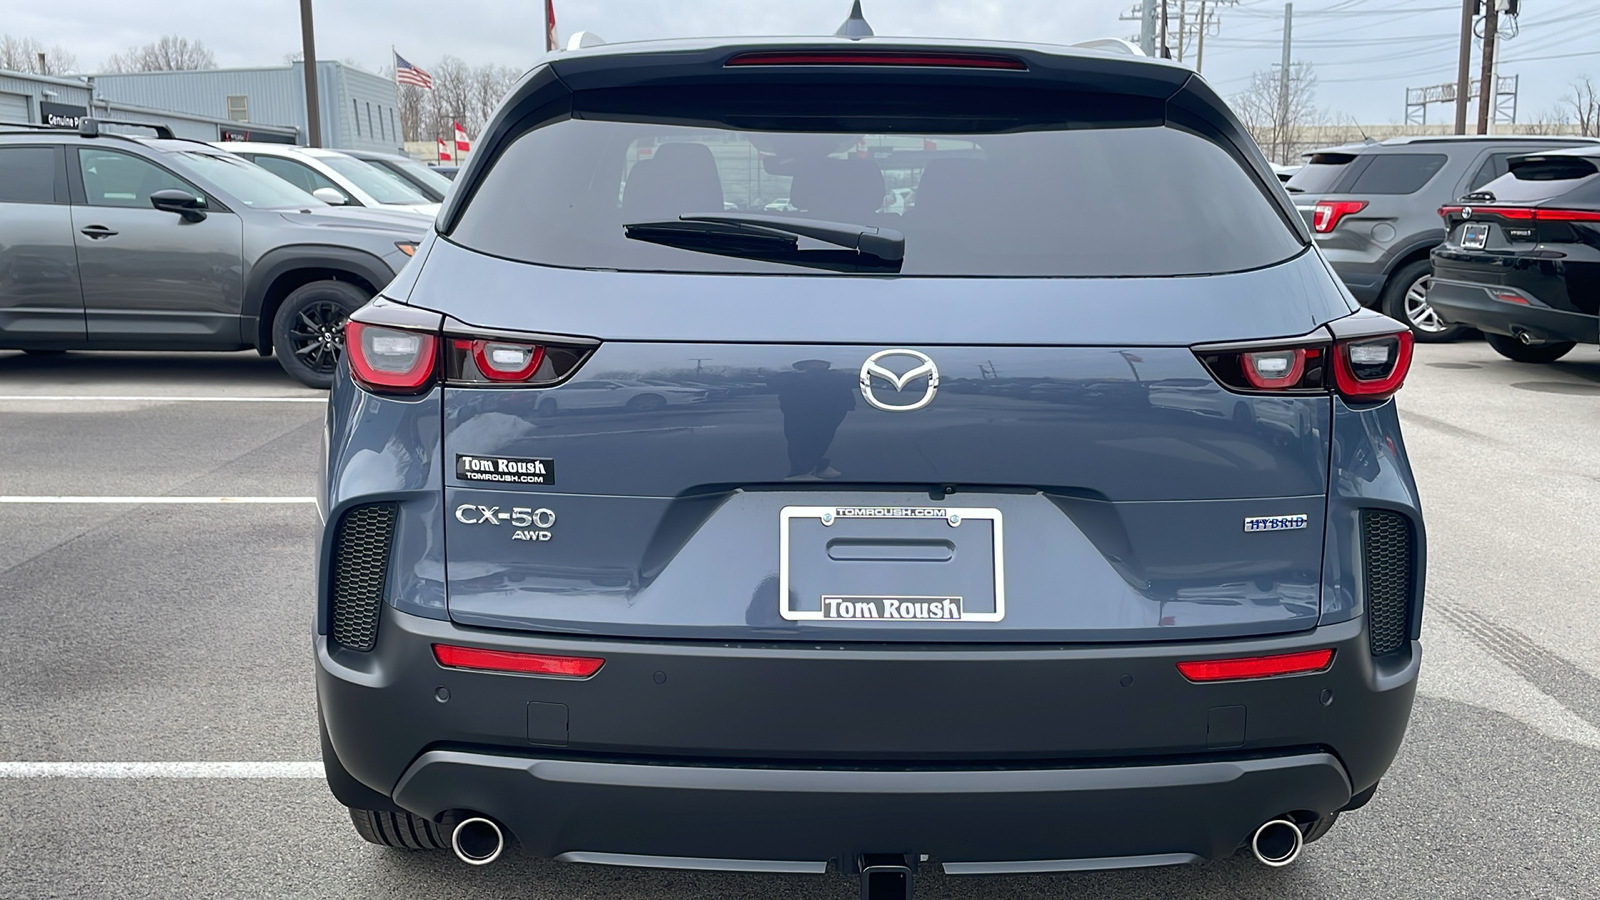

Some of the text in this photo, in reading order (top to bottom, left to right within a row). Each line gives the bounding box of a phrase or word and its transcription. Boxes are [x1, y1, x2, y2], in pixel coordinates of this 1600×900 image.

[462, 456, 547, 475] Tom Roush
[466, 472, 544, 483] TOMROUSH.COM
[455, 503, 556, 528] CX-50
[836, 508, 947, 517] TOMROUSH.COM
[1250, 516, 1304, 530] HYBRID
[511, 530, 552, 541] AWD
[825, 598, 960, 619] Tom Roush
